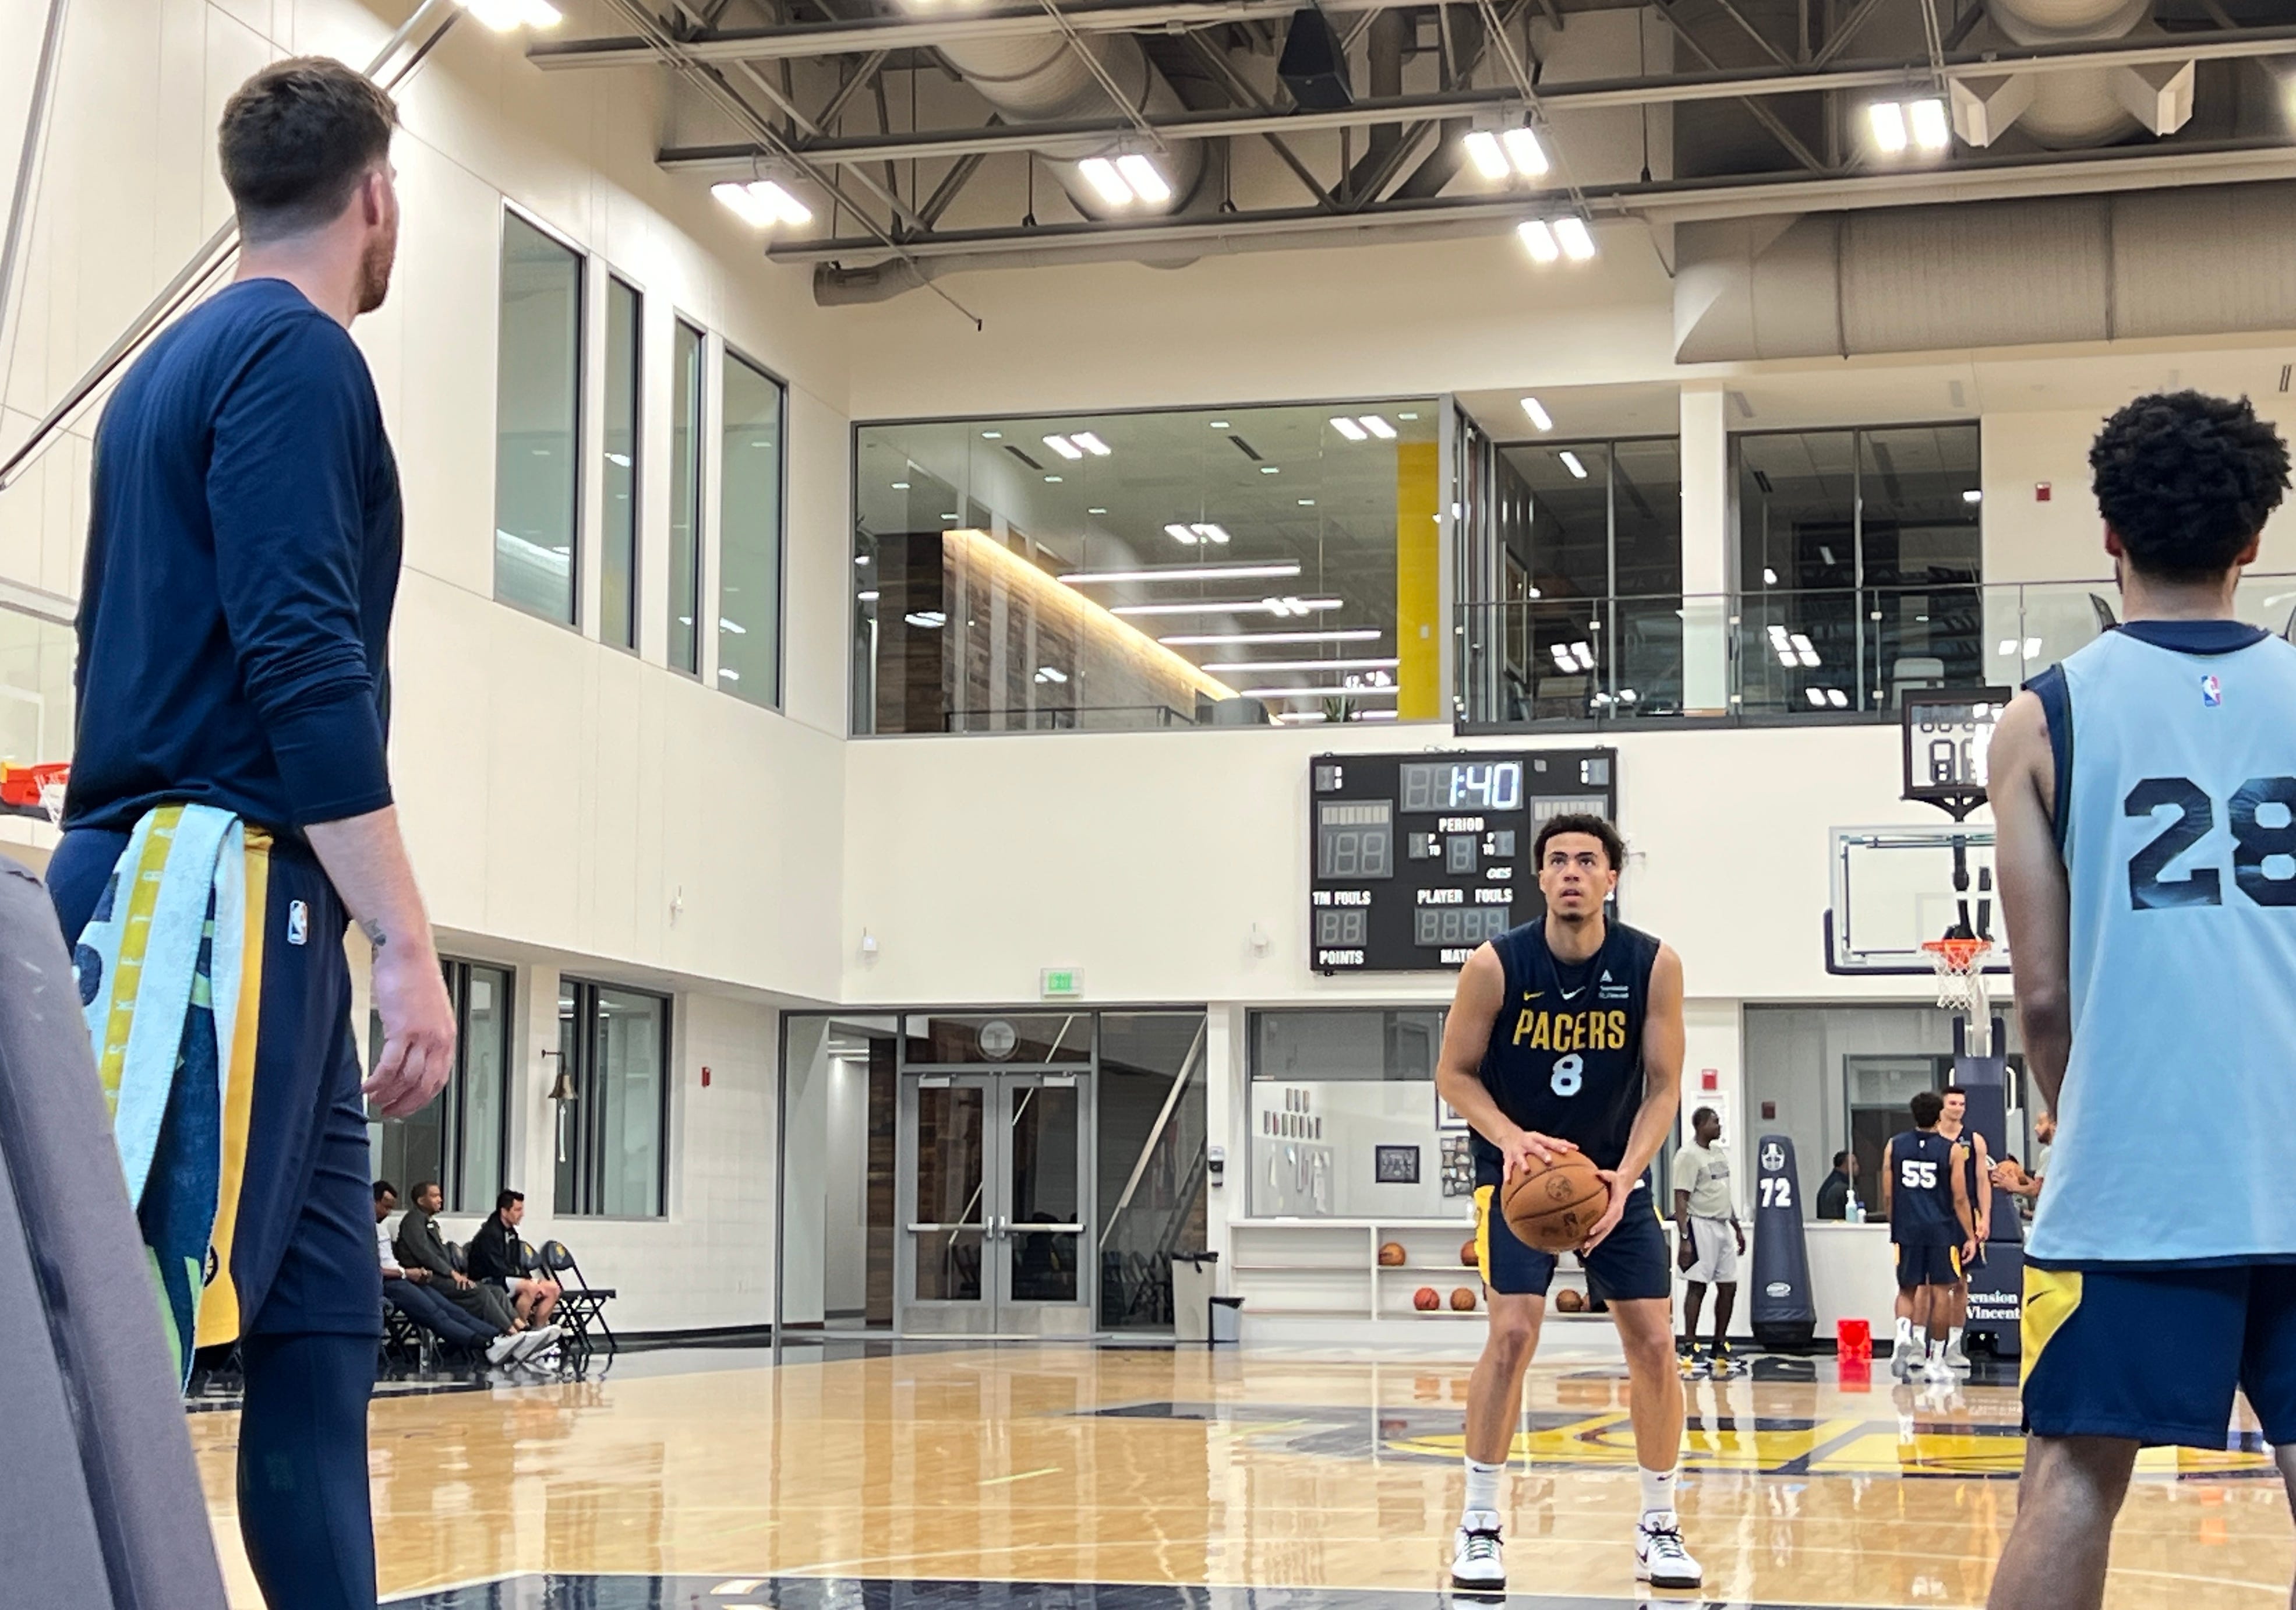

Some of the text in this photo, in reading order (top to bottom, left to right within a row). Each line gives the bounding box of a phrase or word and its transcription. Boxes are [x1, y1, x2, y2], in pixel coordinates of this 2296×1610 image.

[1449, 763, 1519, 808] 1:40
[1439, 817, 1484, 832] PERIOD
[2124, 776, 2296, 910] 28
[1334, 891, 1370, 905] FOULS
[1417, 888, 1513, 905] PLAYER FOULS
[1319, 949, 1364, 965] POINTS
[1513, 1009, 1626, 1053] PACERS
[1550, 1053, 1584, 1096] 8
[1902, 1160, 1937, 1188] 55
[1760, 1177, 1791, 1208] 72
[1967, 1290, 2018, 1304] ension
[1966, 1306, 2021, 1319] Vincent
